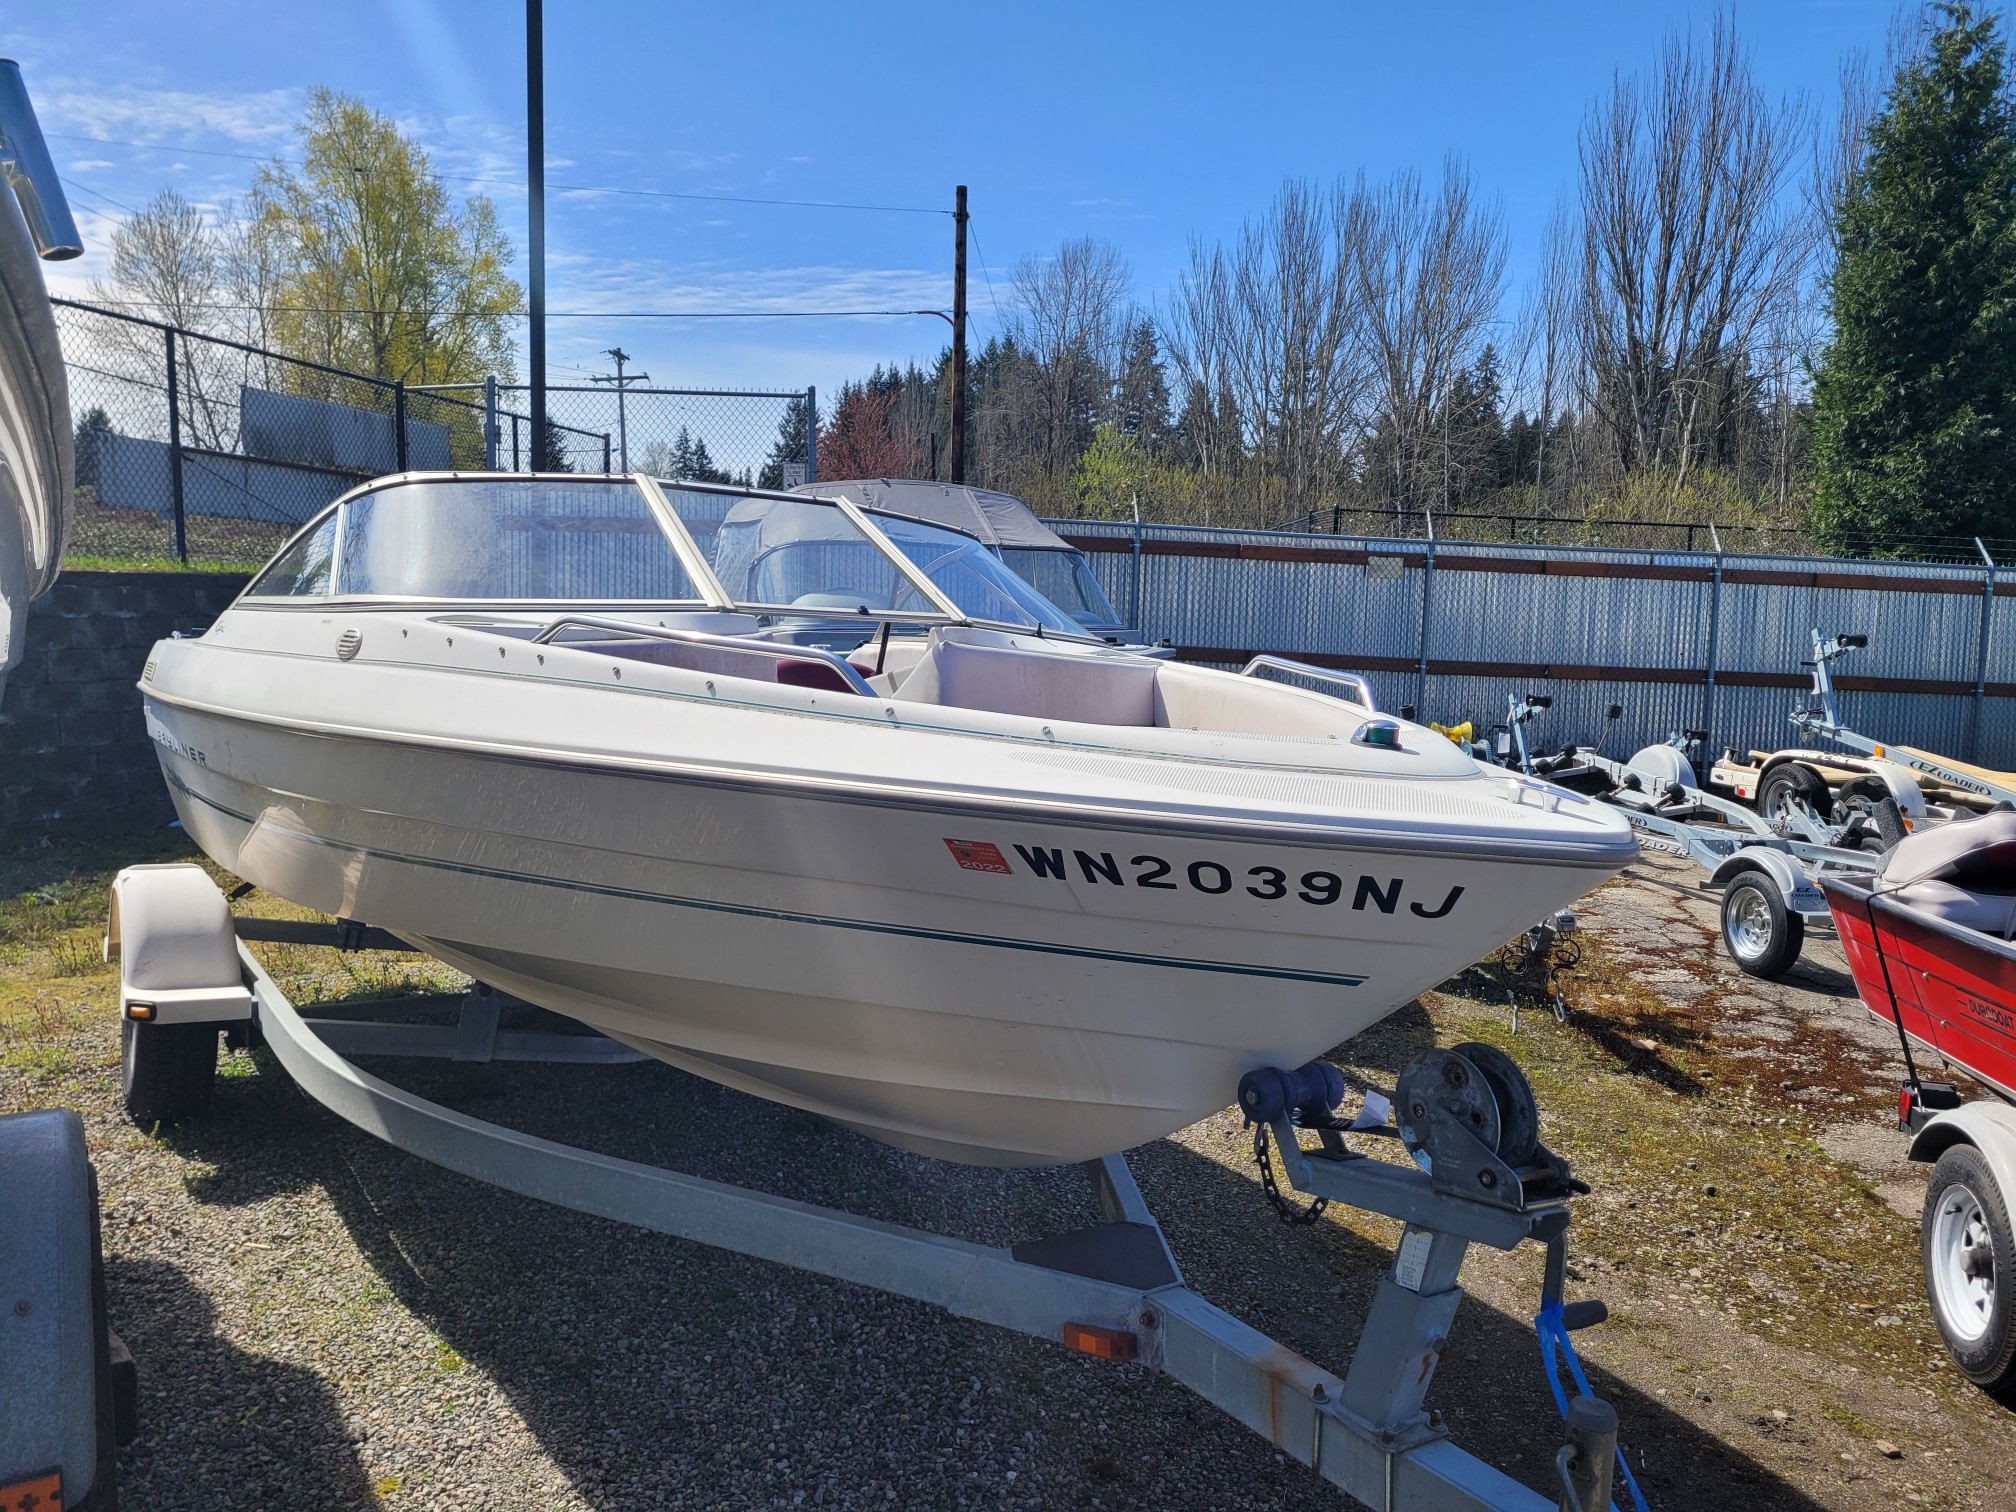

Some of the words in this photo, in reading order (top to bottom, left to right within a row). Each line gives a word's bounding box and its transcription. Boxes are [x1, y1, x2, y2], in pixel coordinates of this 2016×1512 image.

[1638, 838, 1688, 857] OADER
[960, 860, 1008, 873] 2022
[1012, 843, 1466, 919] WN2039NJ
